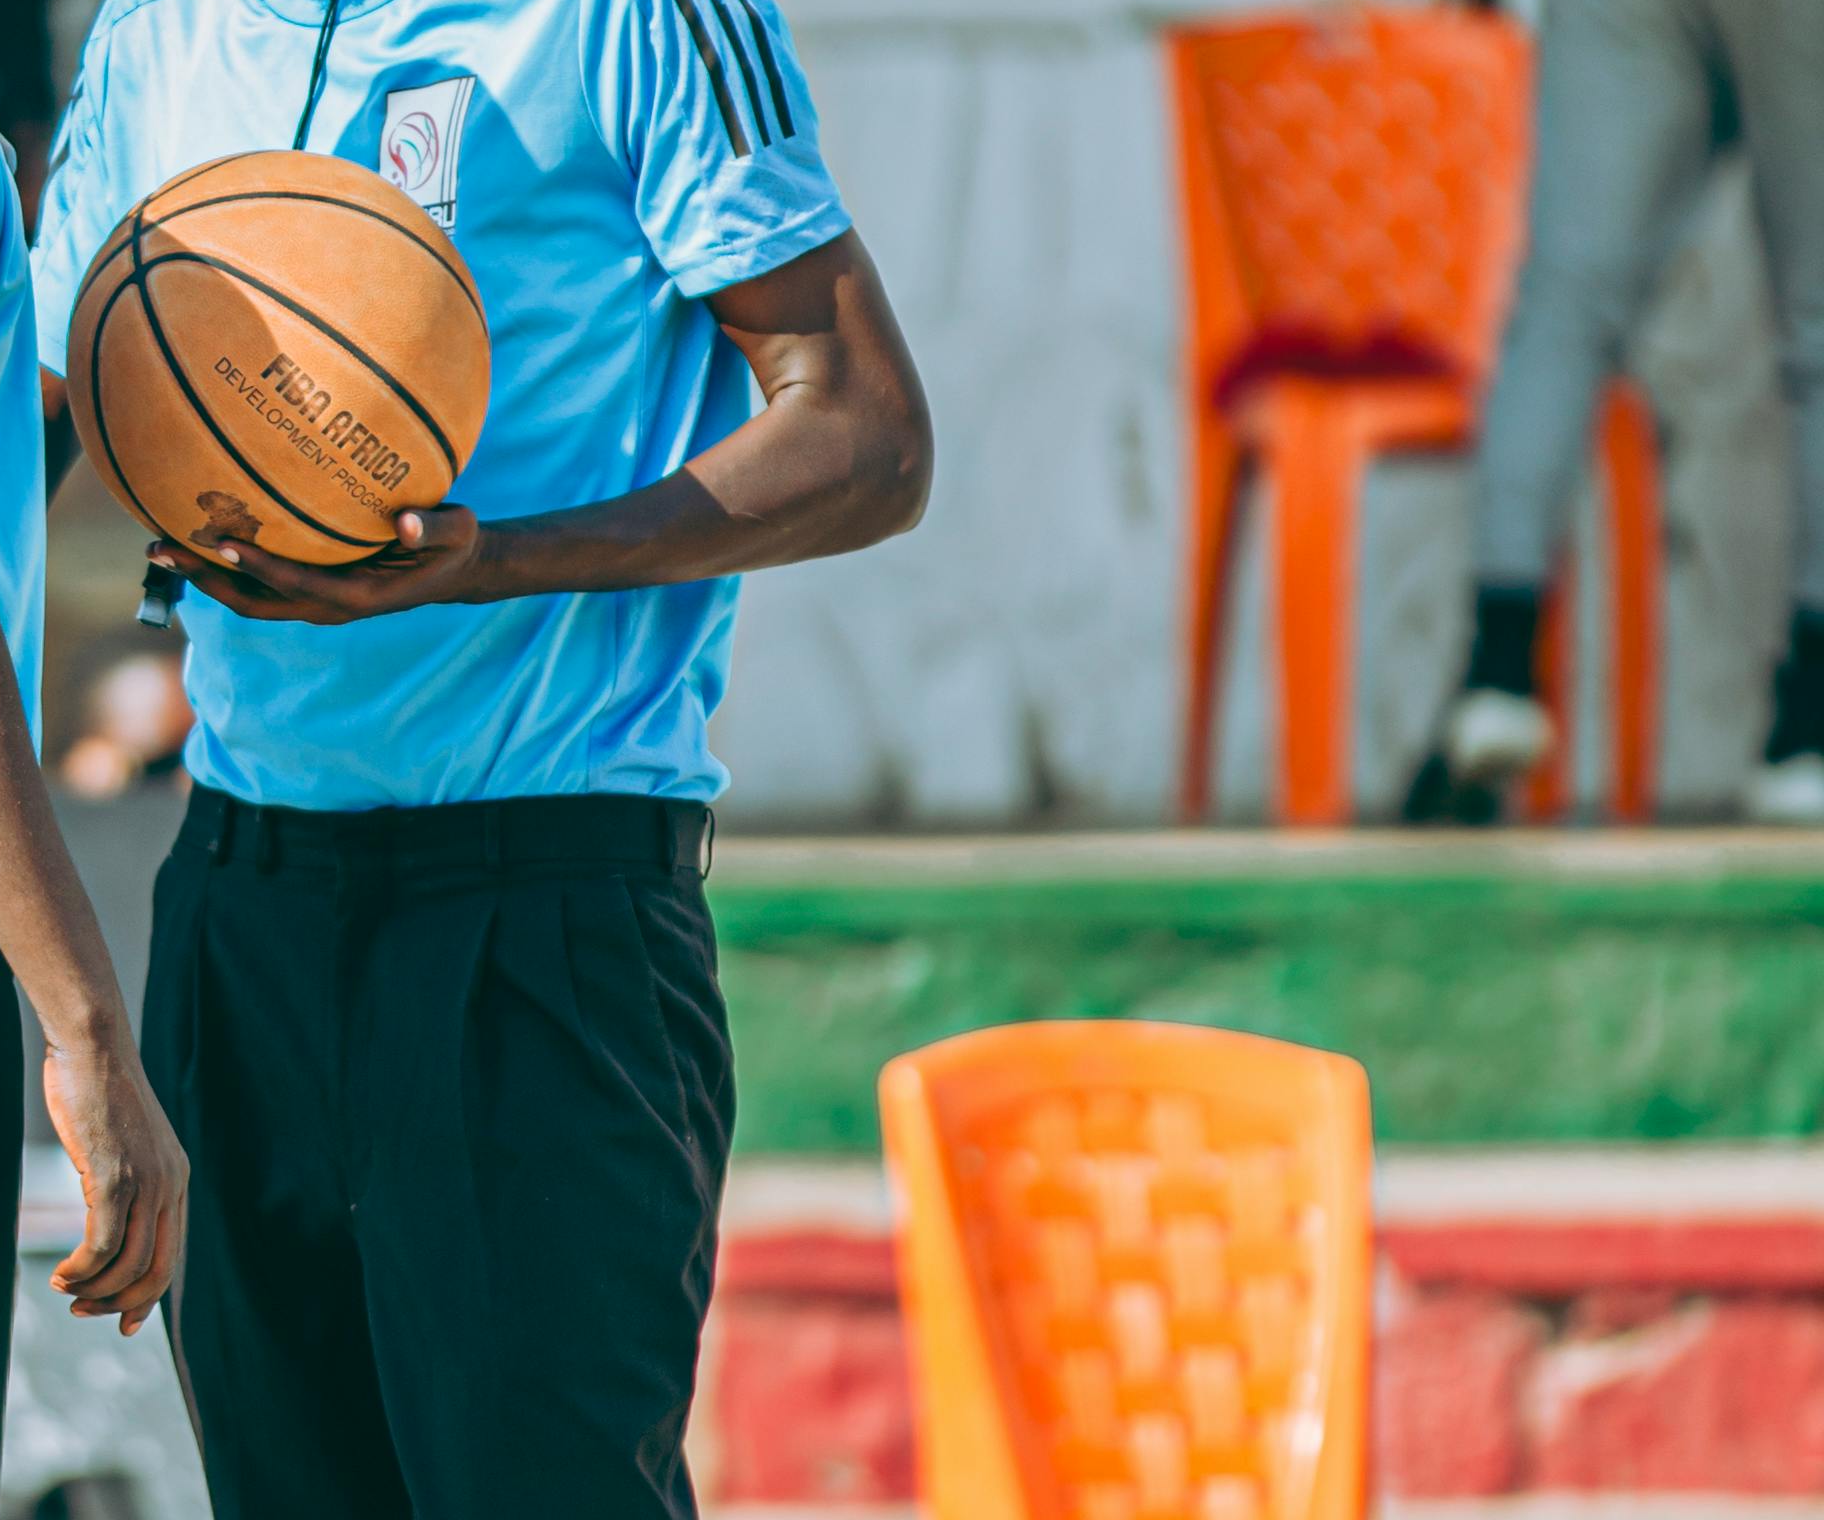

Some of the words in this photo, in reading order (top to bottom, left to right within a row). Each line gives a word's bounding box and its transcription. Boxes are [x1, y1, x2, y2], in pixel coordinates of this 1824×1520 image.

[214, 356, 338, 471] DEVELOPMENT
[260, 353, 331, 424] FIBA
[321, 410, 411, 492] AFRICA
